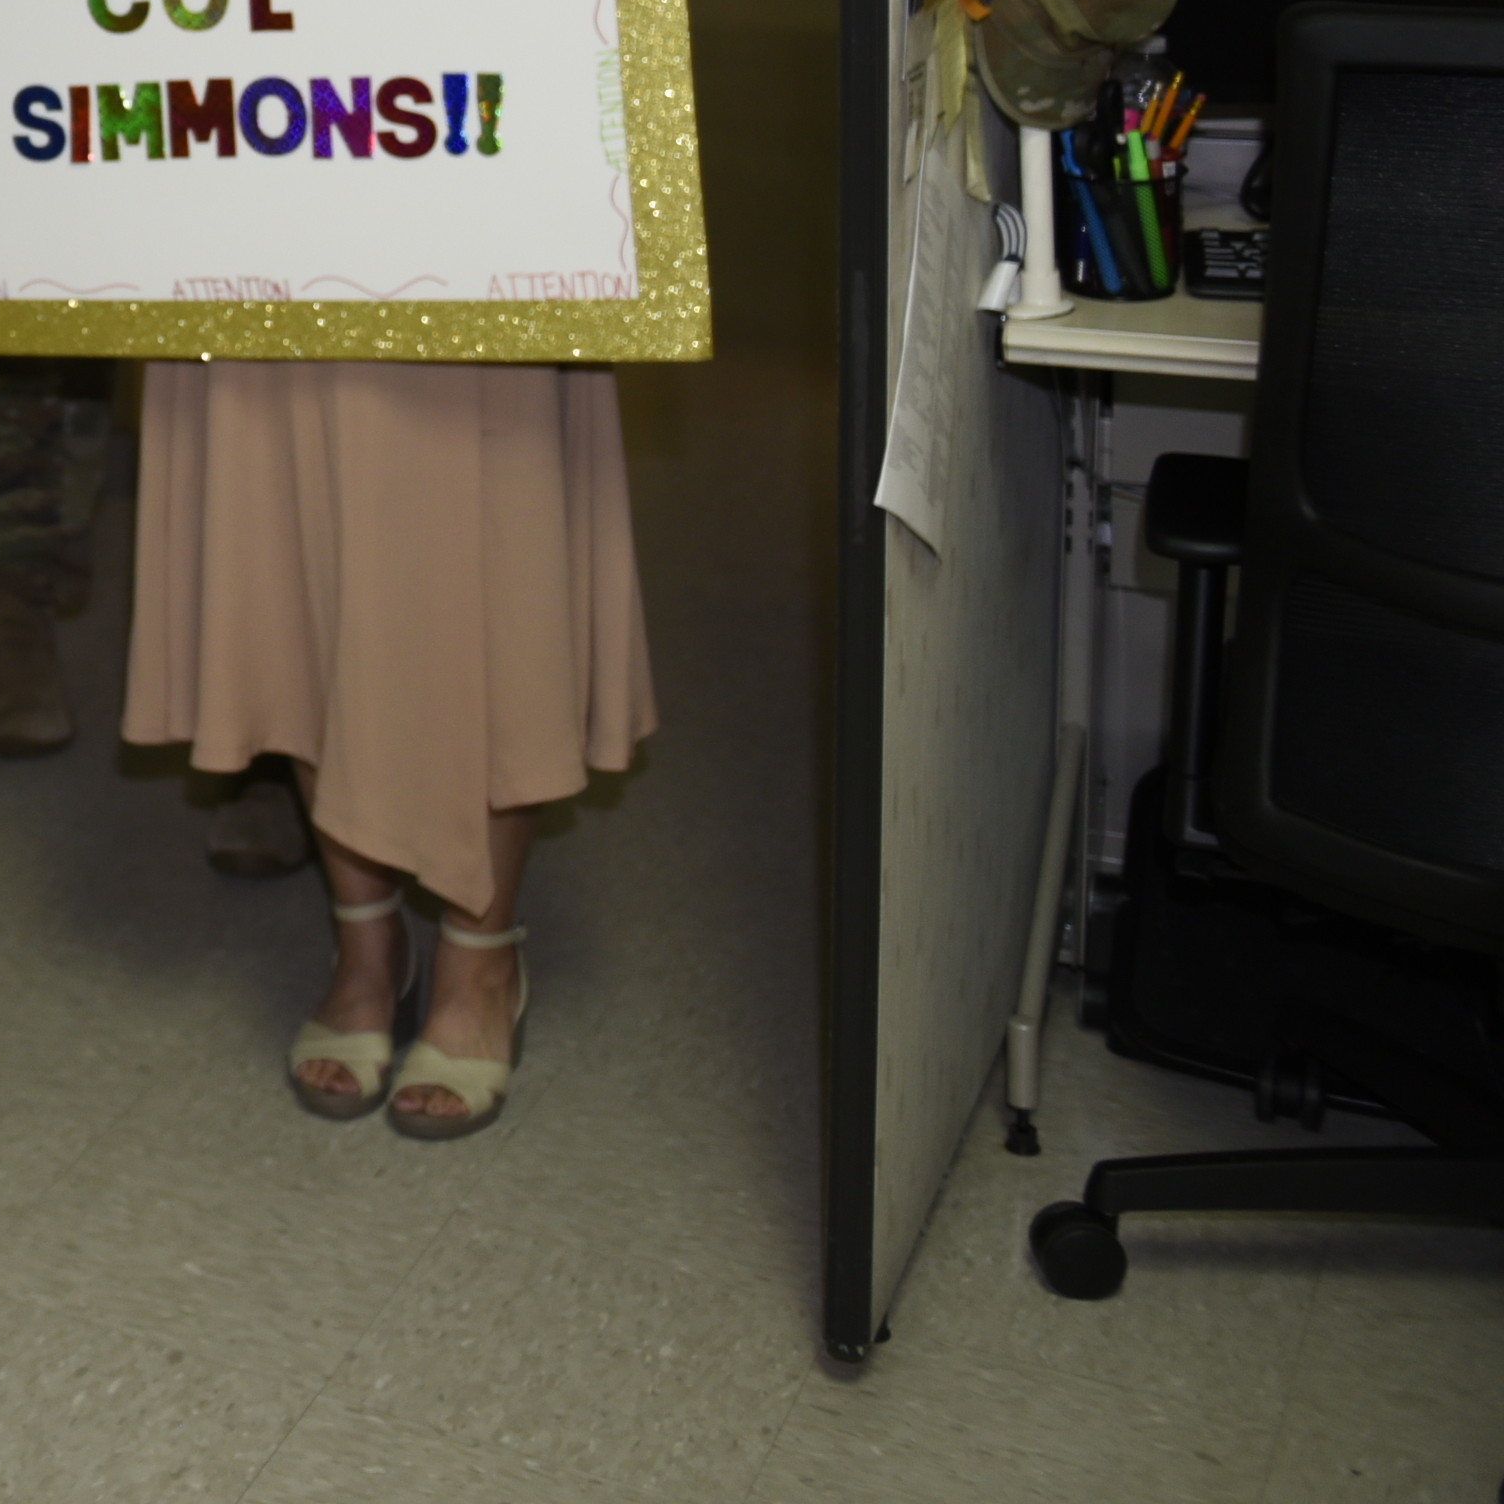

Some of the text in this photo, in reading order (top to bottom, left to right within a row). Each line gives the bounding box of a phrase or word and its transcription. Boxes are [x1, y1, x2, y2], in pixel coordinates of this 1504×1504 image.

[12, 72, 504, 163] SIMMONS!!
[172, 276, 293, 301] ATTENTION
[486, 270, 635, 300] ATTENTION
